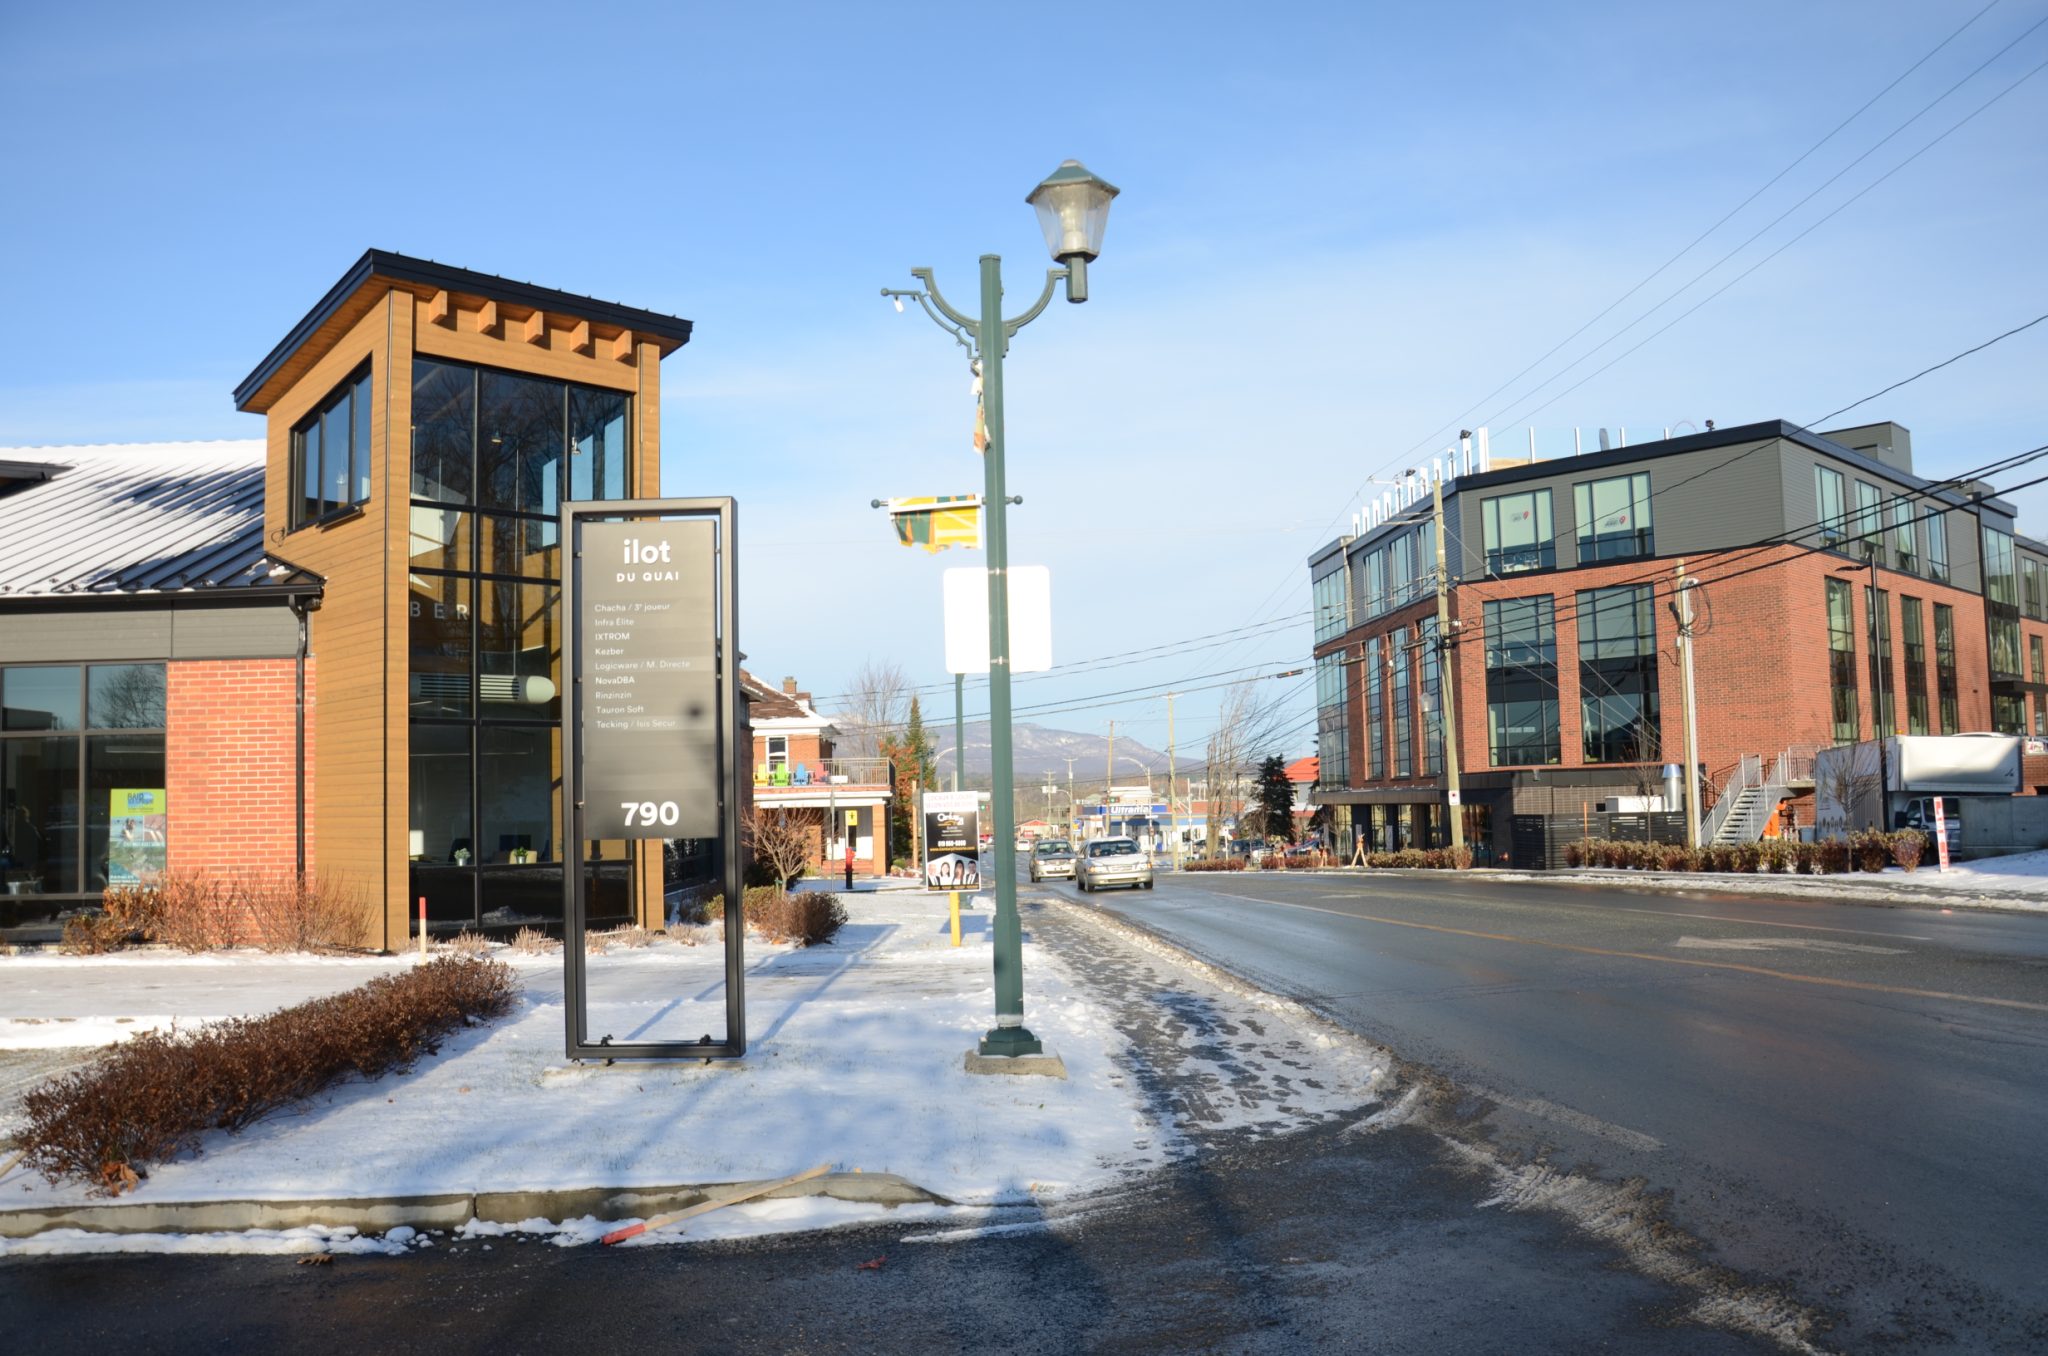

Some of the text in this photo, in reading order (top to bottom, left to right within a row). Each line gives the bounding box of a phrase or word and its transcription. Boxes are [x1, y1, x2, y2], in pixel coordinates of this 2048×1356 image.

[623, 538, 671, 564] ilot
[616, 570, 679, 583] DU QUAI
[594, 603, 626, 612] Chacha
[644, 602, 671, 612] joueur
[595, 618, 614, 627] Infra
[595, 632, 630, 641] IXTROM
[595, 647, 624, 656] Kezber
[595, 661, 638, 672] Logicware
[595, 675, 635, 685] NovaDBA
[595, 691, 632, 700] Rinzinzin
[596, 704, 644, 714] Tauron Soft
[597, 720, 629, 730] Tecking
[621, 801, 679, 827] 790
